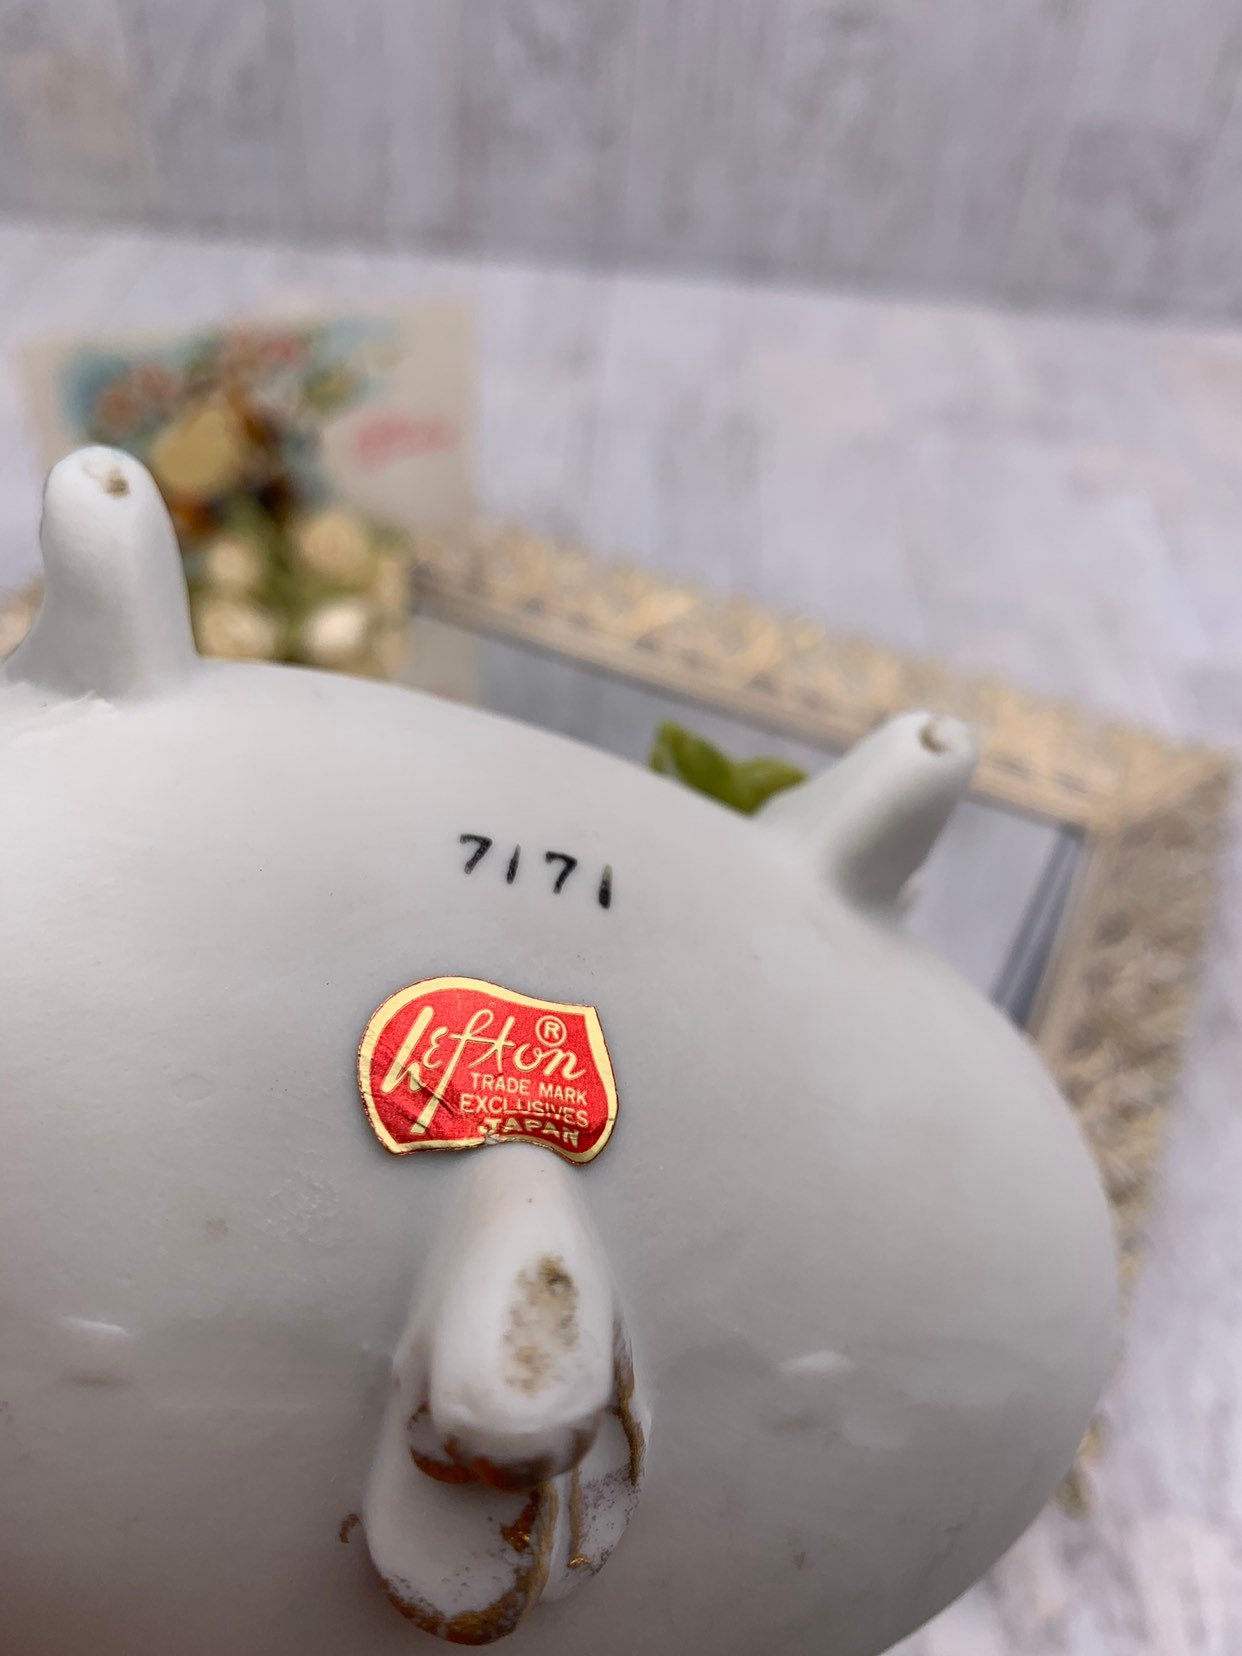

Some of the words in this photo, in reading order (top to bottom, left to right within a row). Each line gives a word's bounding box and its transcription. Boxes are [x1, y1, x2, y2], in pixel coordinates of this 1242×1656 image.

[459, 833, 613, 910] 7171
[380, 1005, 586, 1135] Lefton
[470, 1072, 531, 1095] TRADE
[539, 1082, 588, 1106] MARK
[460, 1093, 589, 1128] EXCLUSIVES
[477, 1117, 579, 1149] JAPAN
